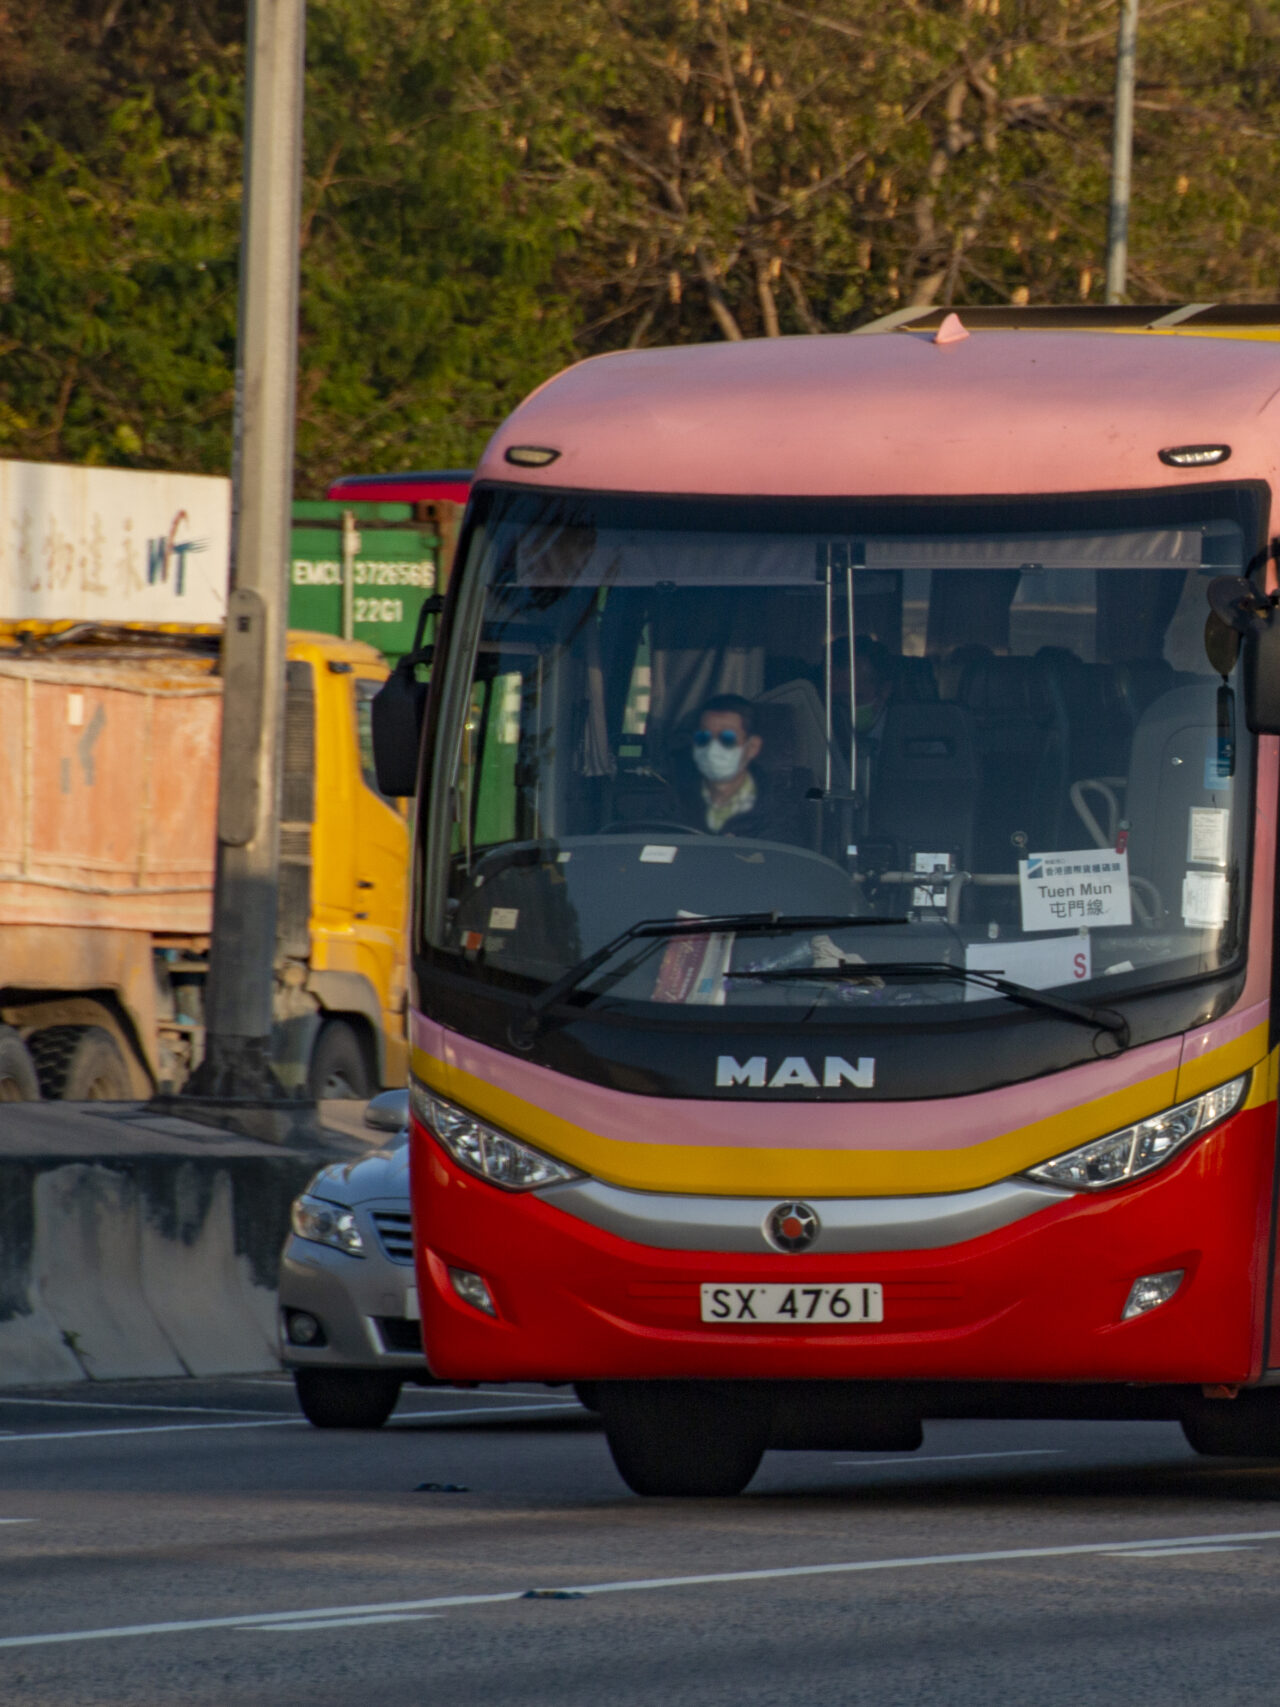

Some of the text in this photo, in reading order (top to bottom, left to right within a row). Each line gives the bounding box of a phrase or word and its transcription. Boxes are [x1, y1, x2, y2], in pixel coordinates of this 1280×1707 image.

[355, 598, 403, 622] 22G1
[1038, 883, 1112, 899] Tuen Mun
[1049, 899, 1104, 918] 屯門線
[1073, 953, 1087, 979] S
[715, 1055, 876, 1088] MAN
[710, 1288, 870, 1320] SX 4761
